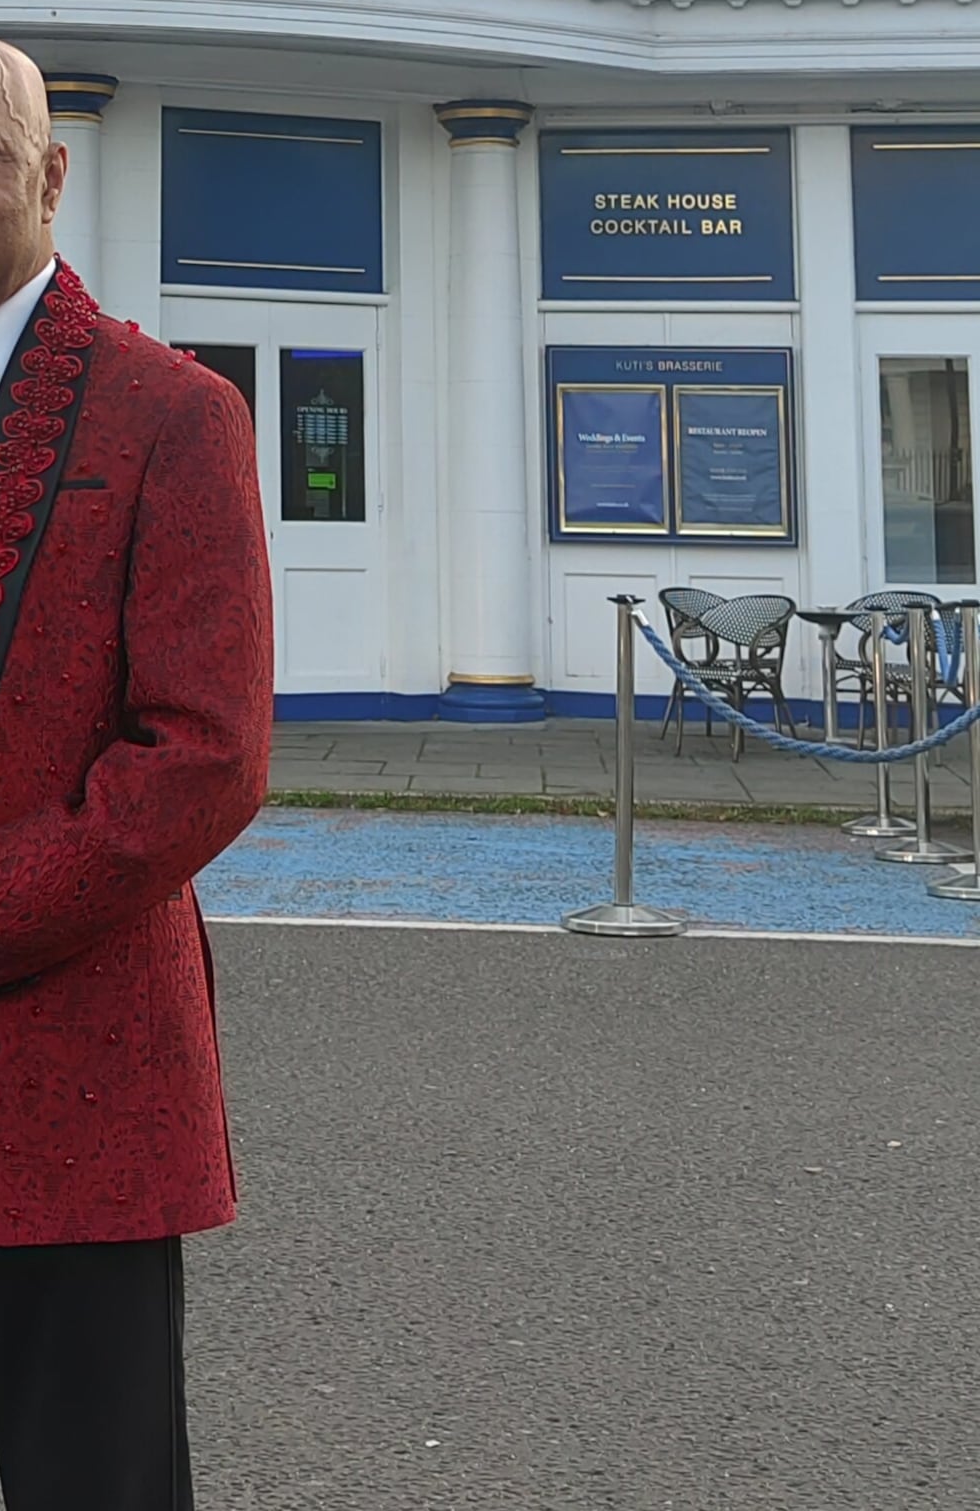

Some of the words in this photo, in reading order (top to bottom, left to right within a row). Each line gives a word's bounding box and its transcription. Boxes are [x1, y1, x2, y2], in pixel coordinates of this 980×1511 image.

[594, 193, 659, 210] STEAK
[667, 193, 737, 209] HOUSE
[590, 219, 692, 236] COCKTAIL
[701, 219, 743, 235] BAR
[615, 360, 654, 372] KUTI'S
[658, 360, 723, 372] BRASSERIE
[688, 427, 736, 436] RESTAURANT
[578, 433, 613, 443] Weddings
[622, 433, 646, 443] Events
